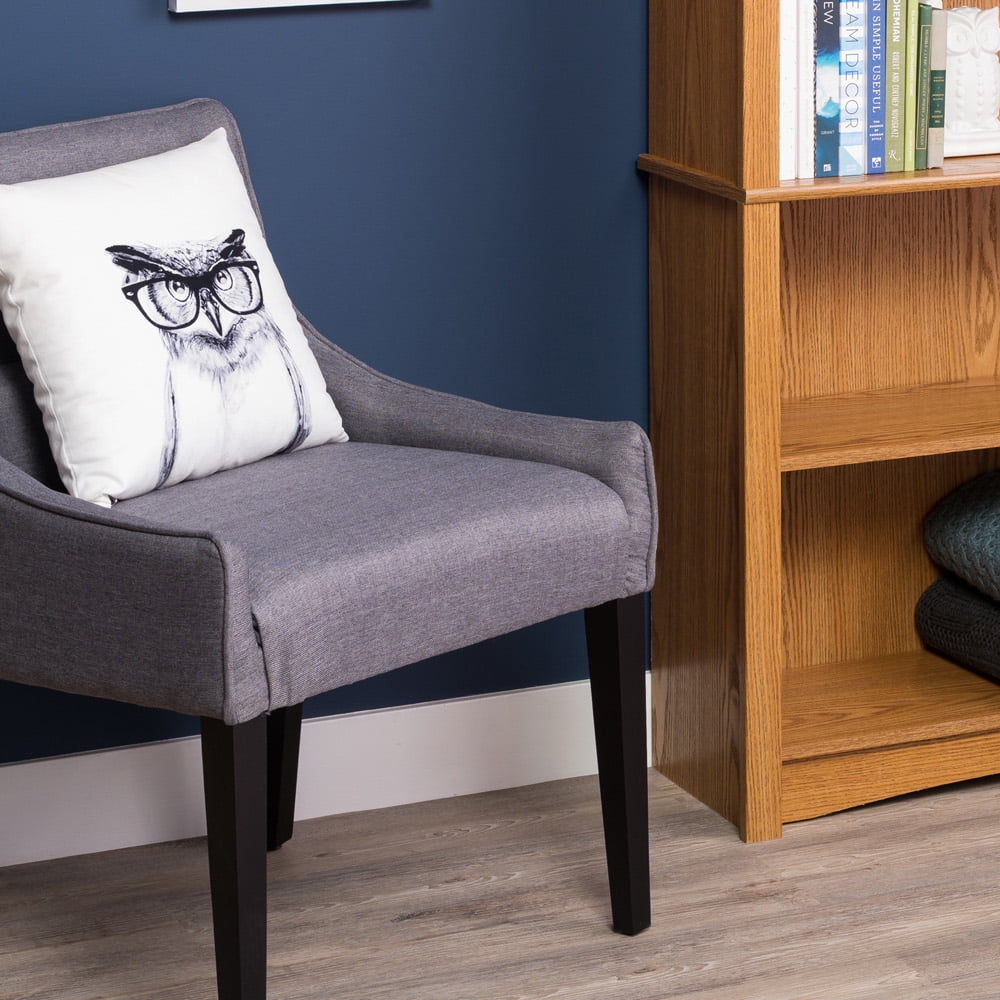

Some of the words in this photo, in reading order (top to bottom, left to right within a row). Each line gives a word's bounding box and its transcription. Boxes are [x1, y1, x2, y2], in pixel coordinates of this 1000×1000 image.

[872, 15, 881, 61] SIMPLE
[845, 53, 859, 128] DECOR
[872, 66, 880, 113] USEFUL
[892, 72, 900, 82] AND
